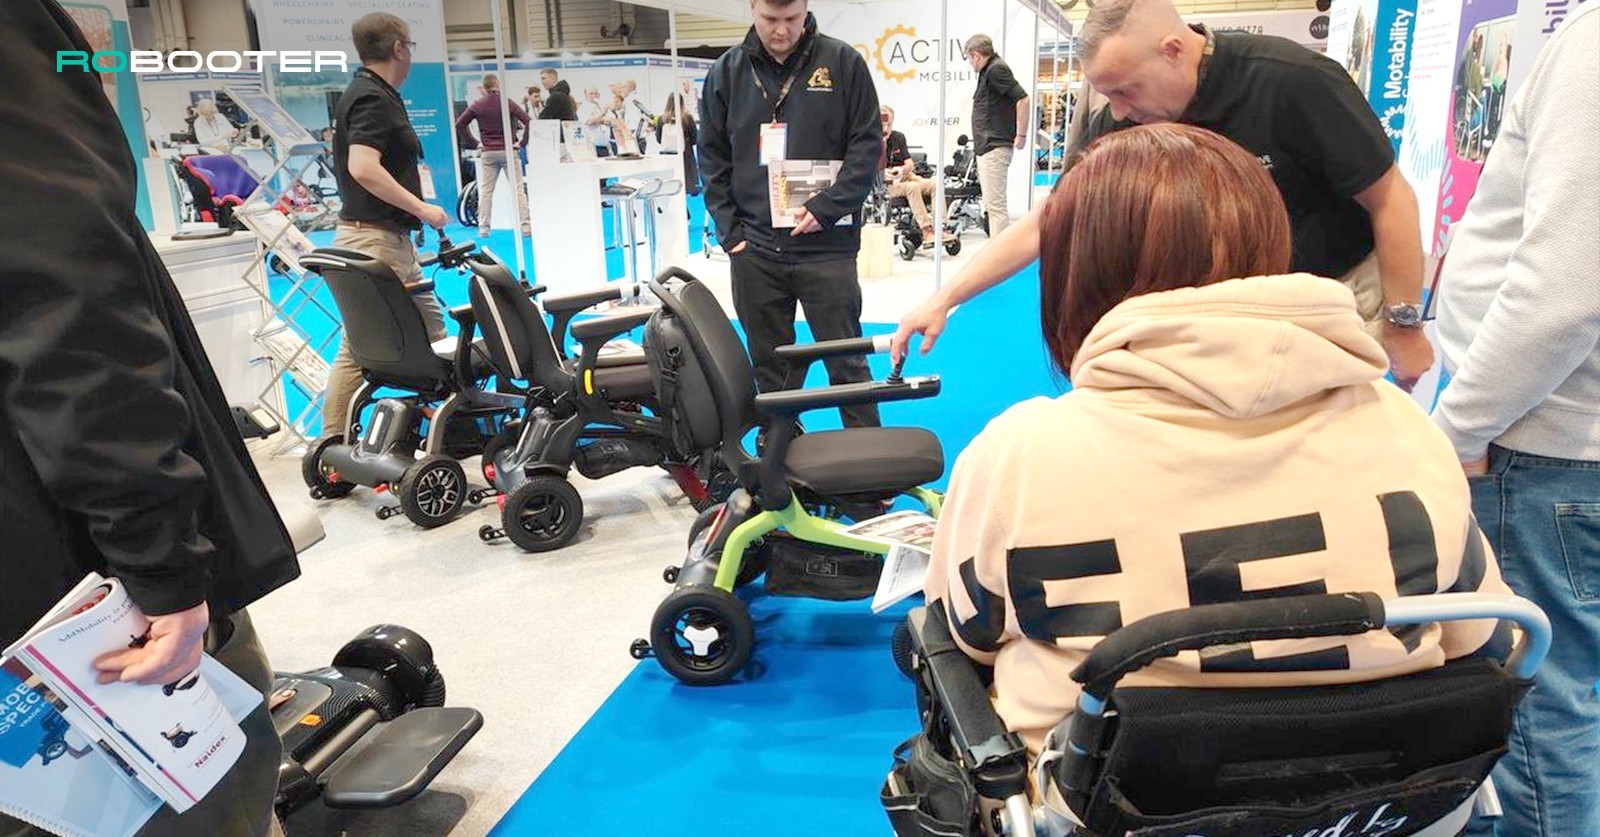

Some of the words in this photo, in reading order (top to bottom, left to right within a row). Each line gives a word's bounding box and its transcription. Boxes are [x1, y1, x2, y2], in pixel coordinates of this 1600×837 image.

[272, 0, 335, 8] WHEELCHAIRS
[397, 1, 431, 9] SEATING
[306, 34, 345, 42] CLINICAL
[889, 38, 968, 64] ACTIV
[1383, 8, 1414, 99] Motability
[919, 71, 978, 82] MOBILIT
[194, 735, 226, 768] Naidex
